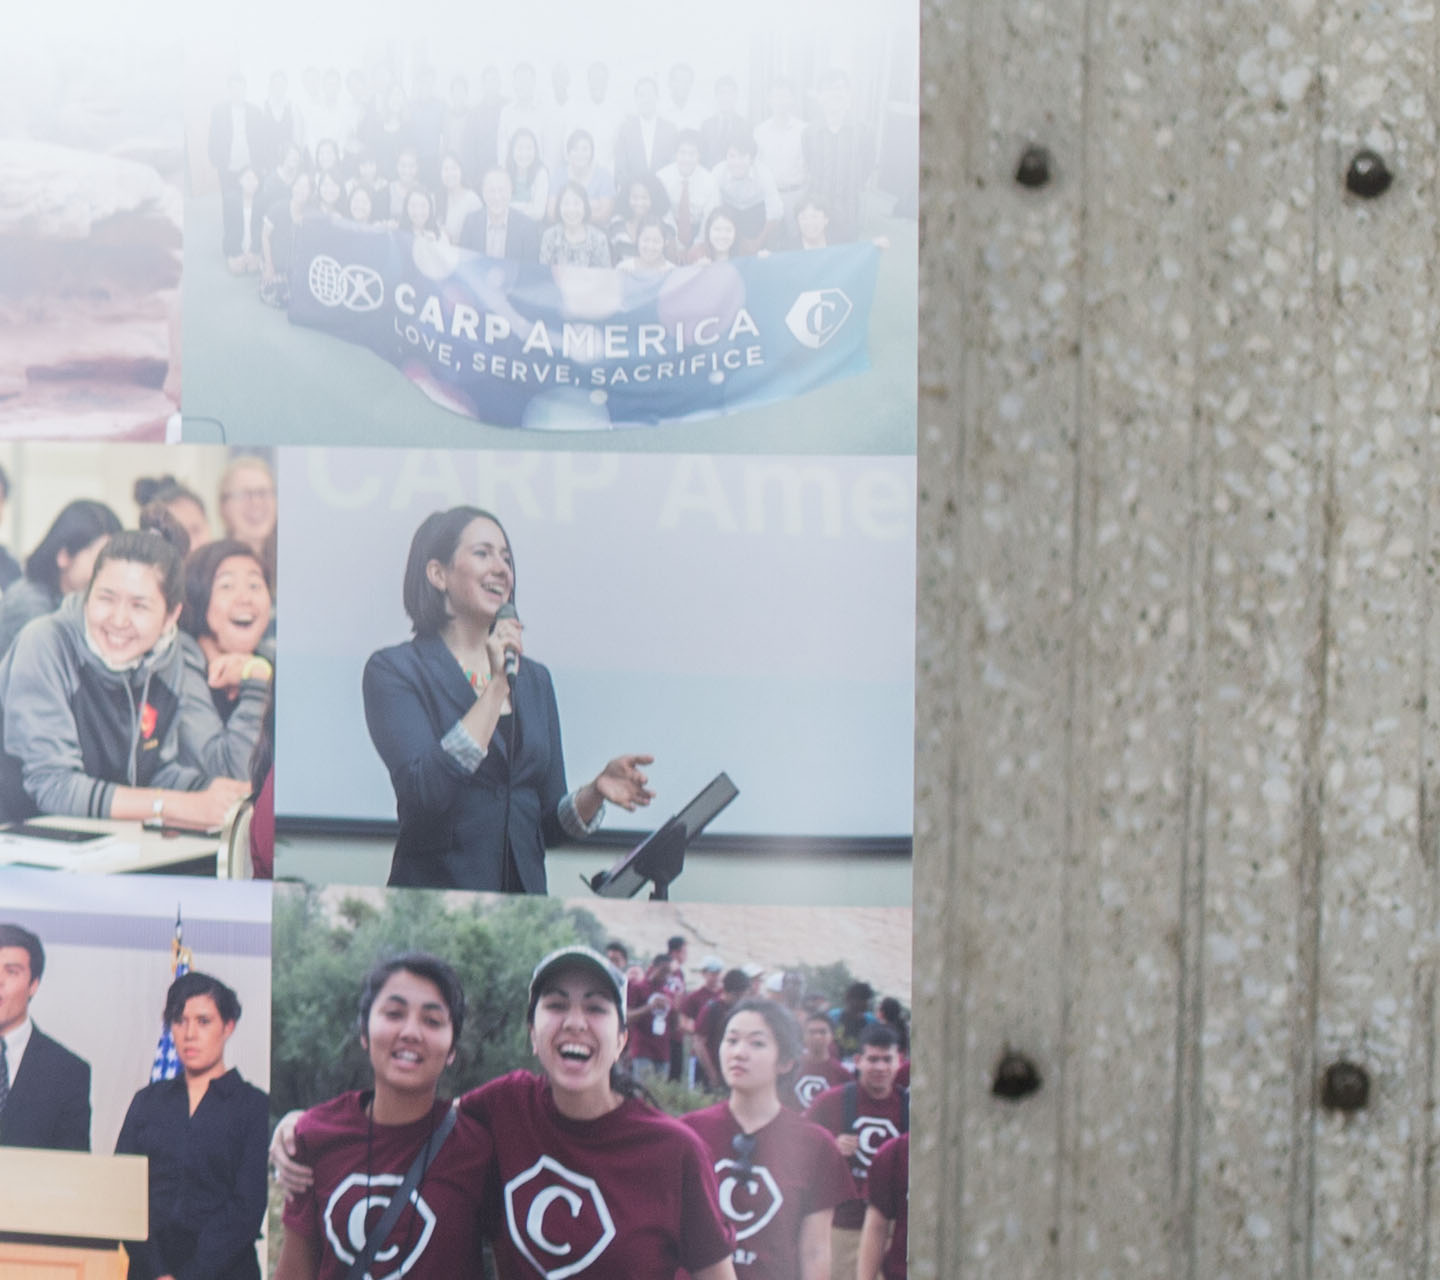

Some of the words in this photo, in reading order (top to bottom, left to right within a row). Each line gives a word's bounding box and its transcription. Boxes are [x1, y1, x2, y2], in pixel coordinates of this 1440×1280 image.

[394, 282, 511, 344] CARP
[522, 307, 761, 362] AMERICA
[394, 315, 463, 372] LOVE,
[589, 345, 765, 387] SACRIFICE
